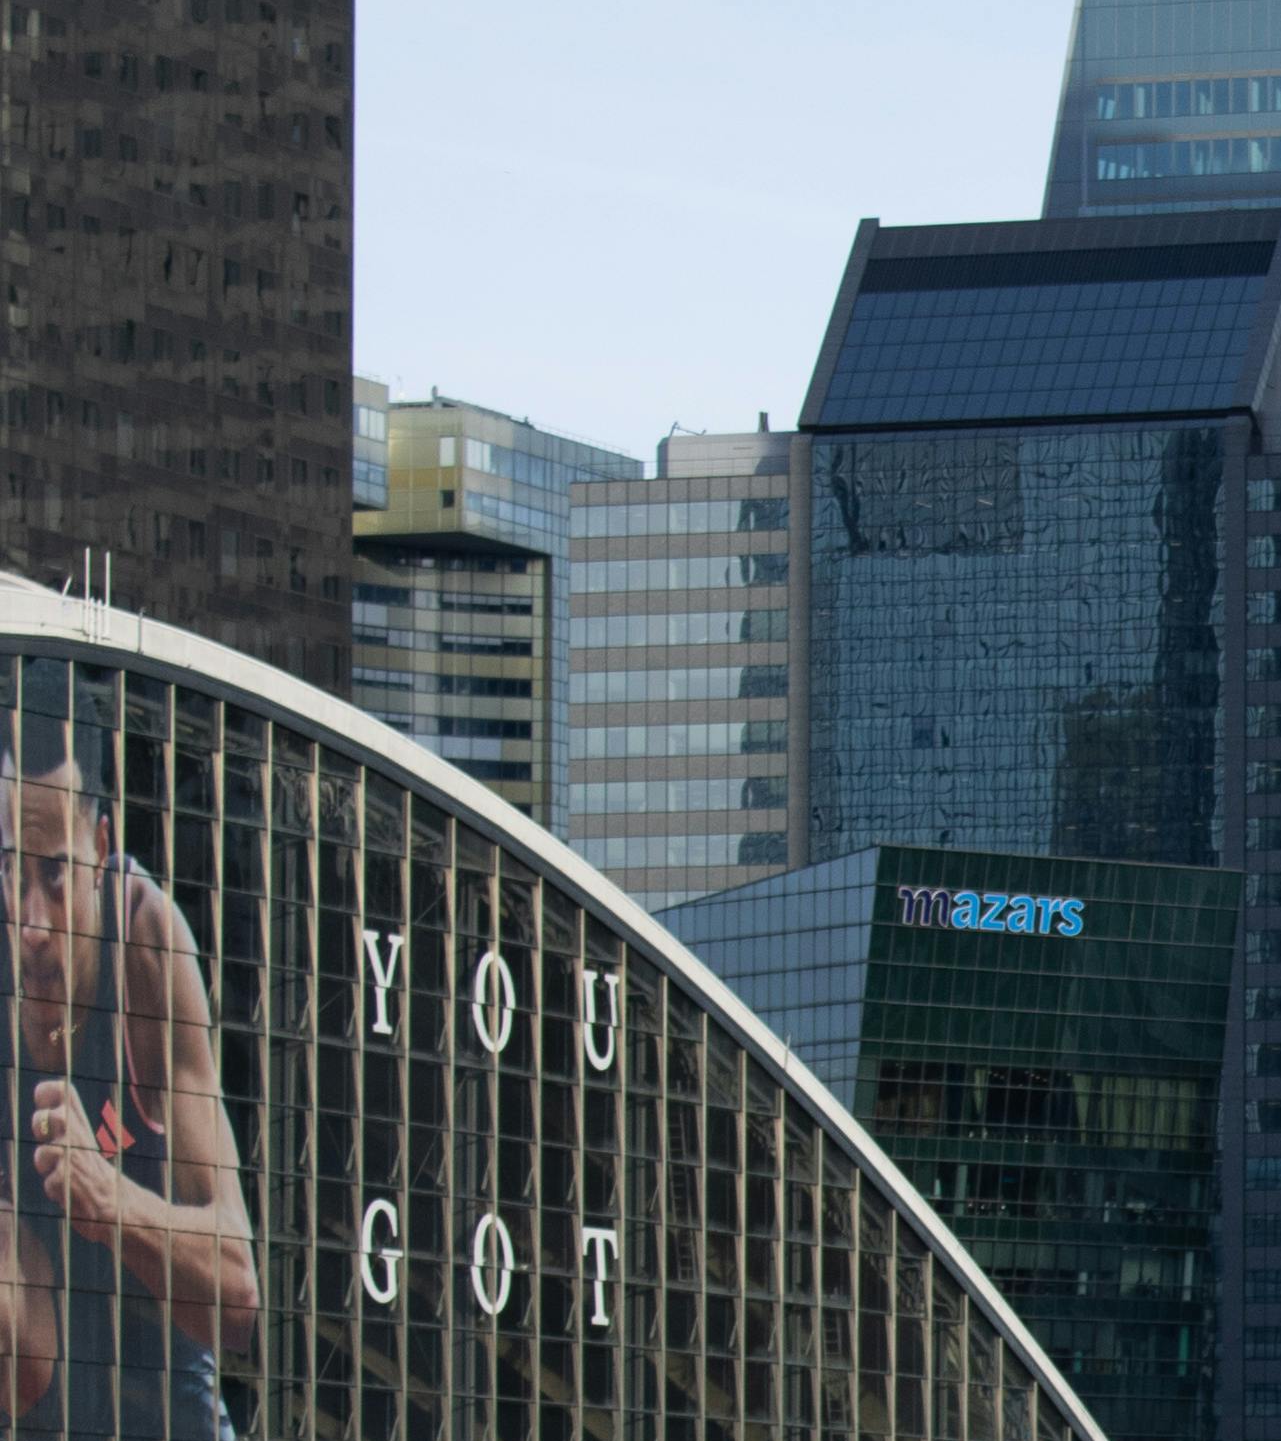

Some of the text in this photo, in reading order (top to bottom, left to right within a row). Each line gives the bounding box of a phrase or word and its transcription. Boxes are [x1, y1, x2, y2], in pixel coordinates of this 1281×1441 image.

[898, 884, 1086, 937] mazars
[362, 929, 620, 1072] YOU
[360, 1198, 620, 1327] GOT
